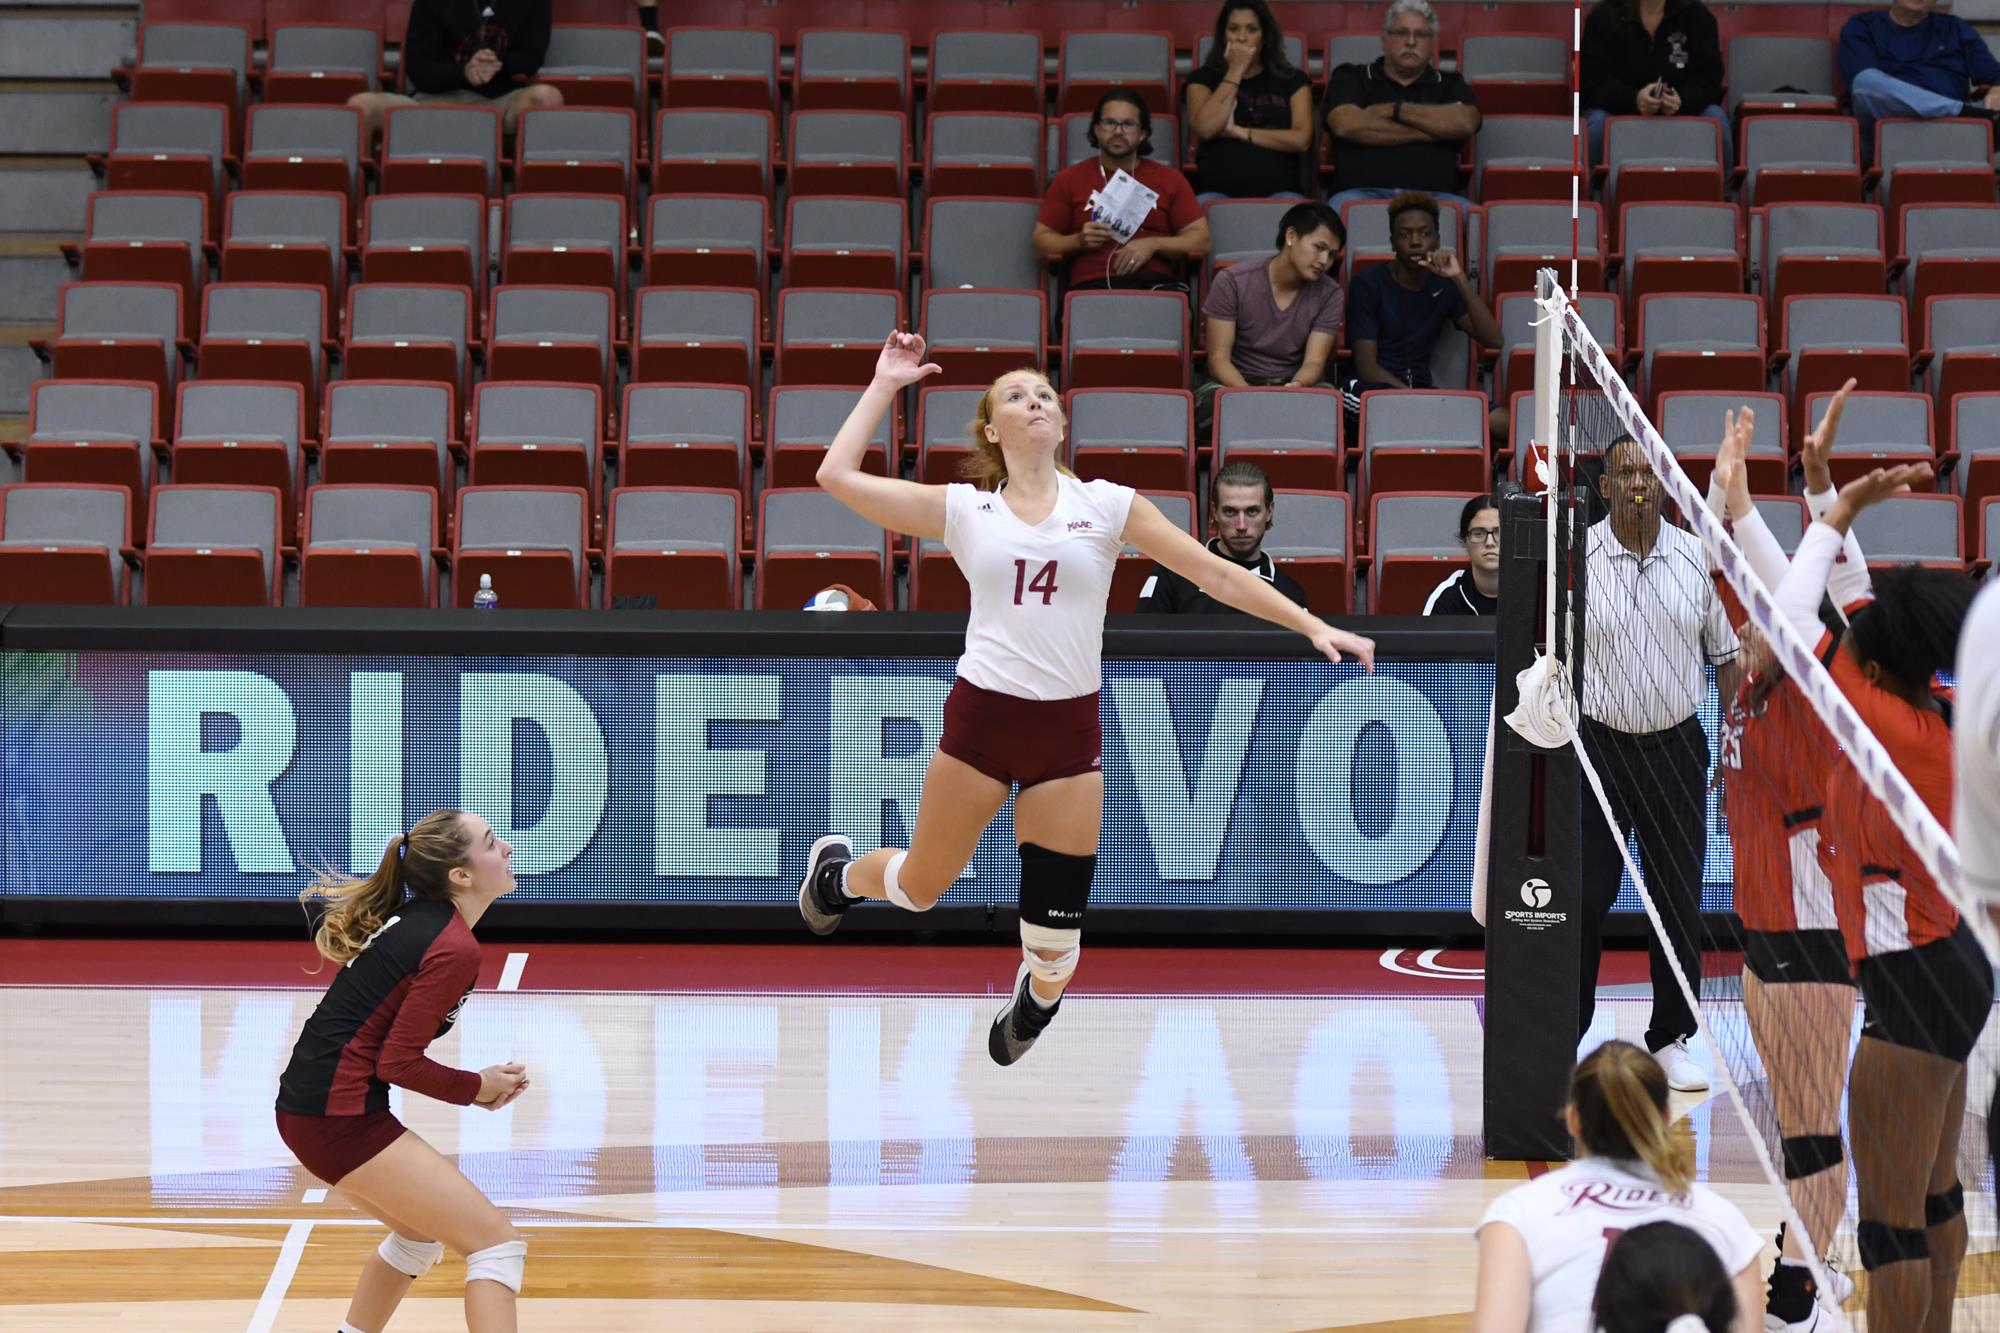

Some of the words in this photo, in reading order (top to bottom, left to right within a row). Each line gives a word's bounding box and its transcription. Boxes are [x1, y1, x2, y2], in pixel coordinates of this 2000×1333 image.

[1013, 558, 1059, 606] 14
[148, 669, 977, 879] RIDER
[1505, 910, 1533, 919] SPORTS
[1535, 911, 1566, 921] IMPORTS
